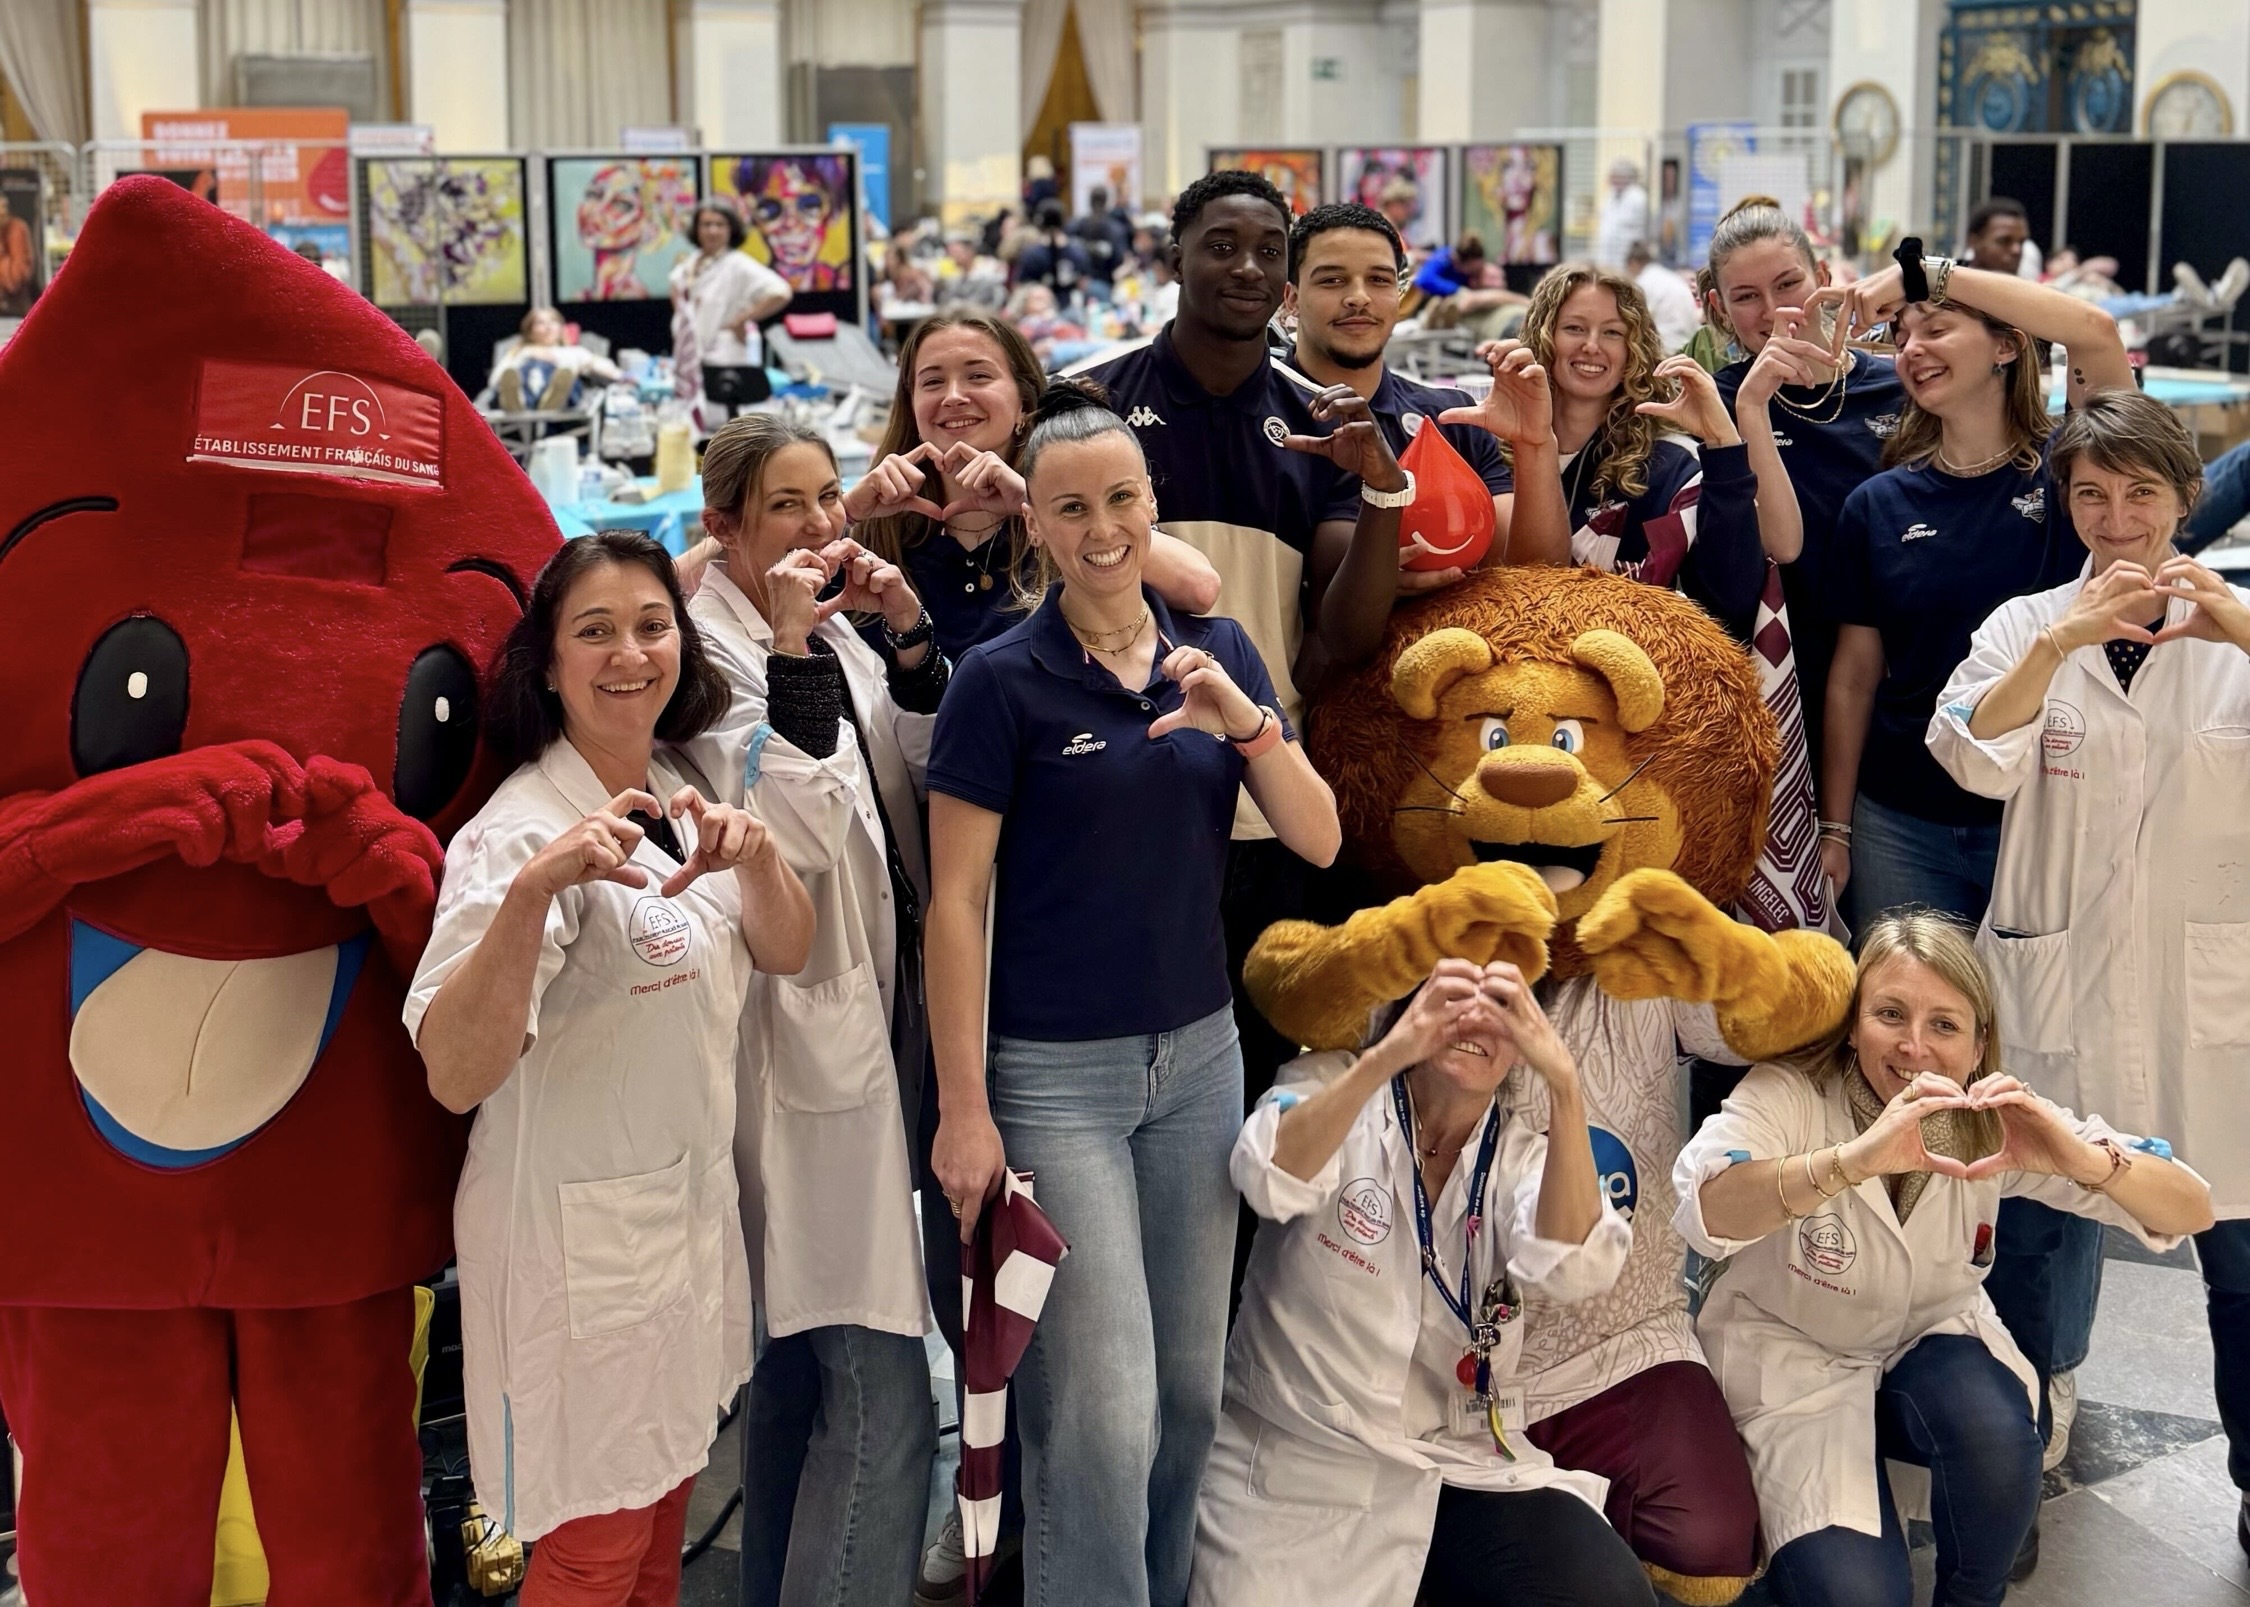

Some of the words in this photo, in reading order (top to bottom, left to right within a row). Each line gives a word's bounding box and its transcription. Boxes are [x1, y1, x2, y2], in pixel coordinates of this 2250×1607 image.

[300, 392, 371, 436] EFS
[194, 433, 322, 459] ÉTABLISSEMENT
[394, 456, 410, 471] DU
[1062, 741, 1107, 756] eldera
[1747, 876, 1790, 924] INGELEC
[648, 912, 671, 931] EFS
[630, 981, 661, 996] Merci
[663, 973, 688, 988] d'être
[1317, 1233, 1341, 1253] Merci
[1341, 1249, 1365, 1267] d'être
[1816, 1232, 1839, 1245] EFS
[1788, 1263, 1812, 1281] Merci
[1813, 1278, 1839, 1292] d'être
